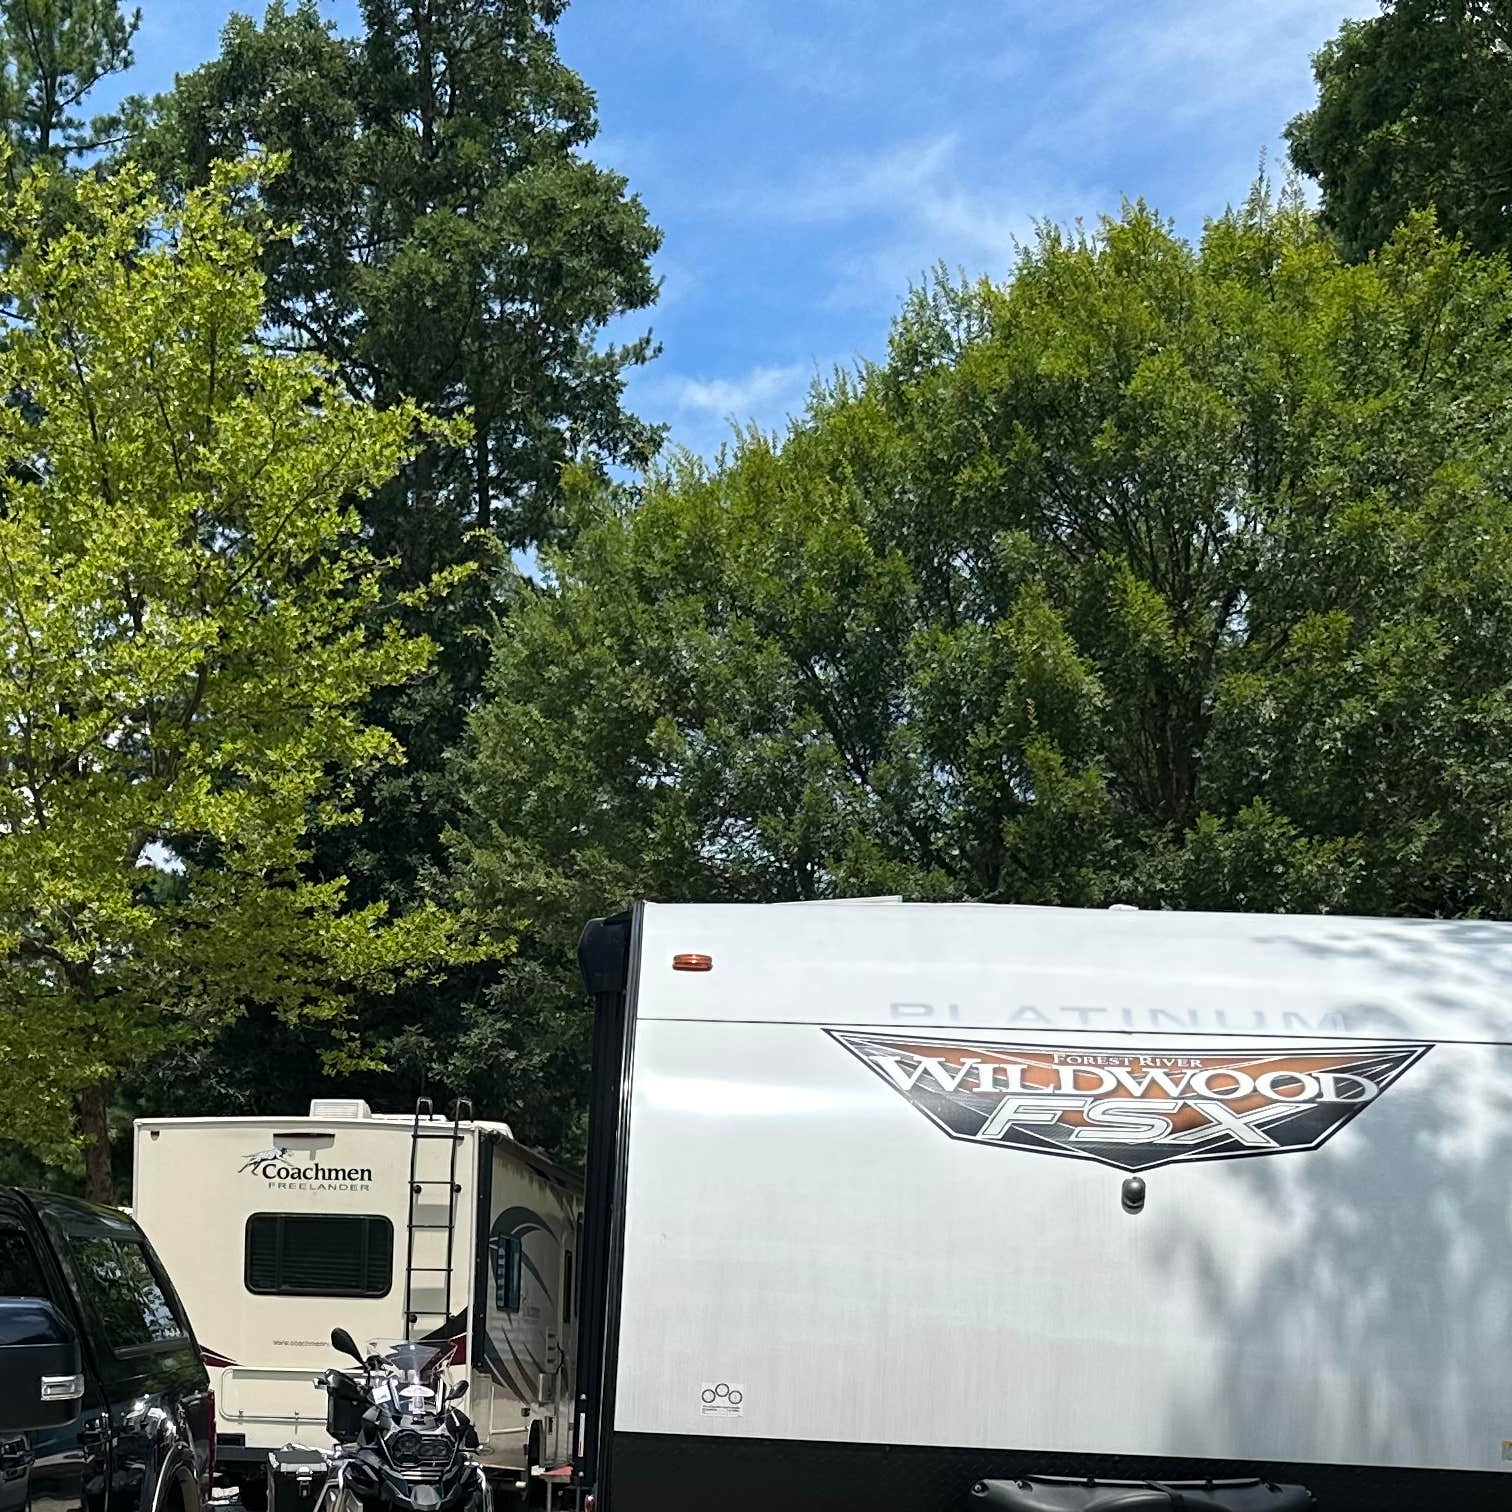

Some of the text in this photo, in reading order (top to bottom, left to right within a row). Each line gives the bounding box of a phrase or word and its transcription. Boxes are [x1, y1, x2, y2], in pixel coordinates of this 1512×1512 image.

[889, 1002, 1346, 1033] PLATINUM
[1052, 1052, 1203, 1069] FOREST RIVER
[869, 1055, 1380, 1102] WILDWOOD
[976, 1096, 1319, 1147] FSX
[262, 1163, 373, 1181] Coachmen
[268, 1182, 371, 1191] FREELANDER
